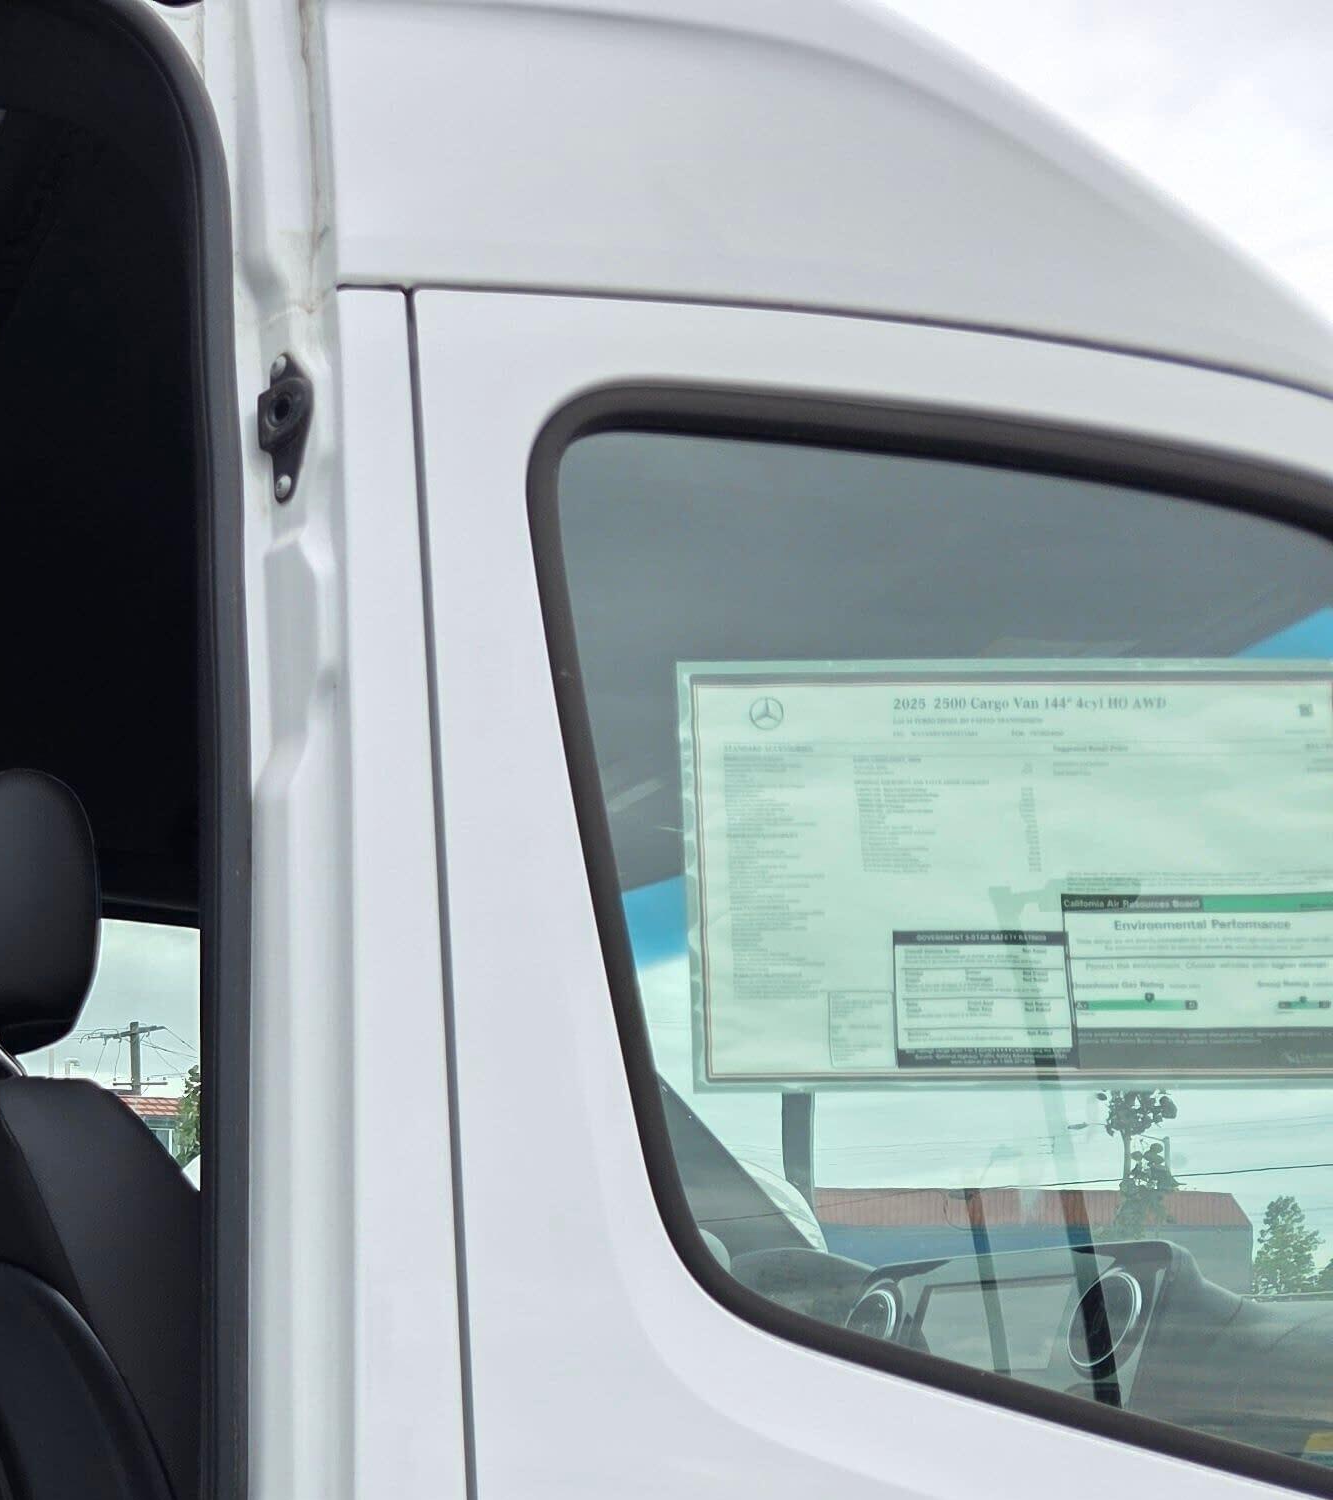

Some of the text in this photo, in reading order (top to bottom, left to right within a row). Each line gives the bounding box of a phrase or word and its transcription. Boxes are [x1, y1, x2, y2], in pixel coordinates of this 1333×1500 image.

[893, 697, 926, 710] 2025
[934, 697, 966, 710] 2500
[970, 697, 1009, 712] Cargo
[1013, 697, 1039, 710] Van
[1132, 696, 1166, 710] AWD
[1064, 899, 1200, 908] California Air Resources Board
[1114, 919, 1291, 931] Environmental Performance
